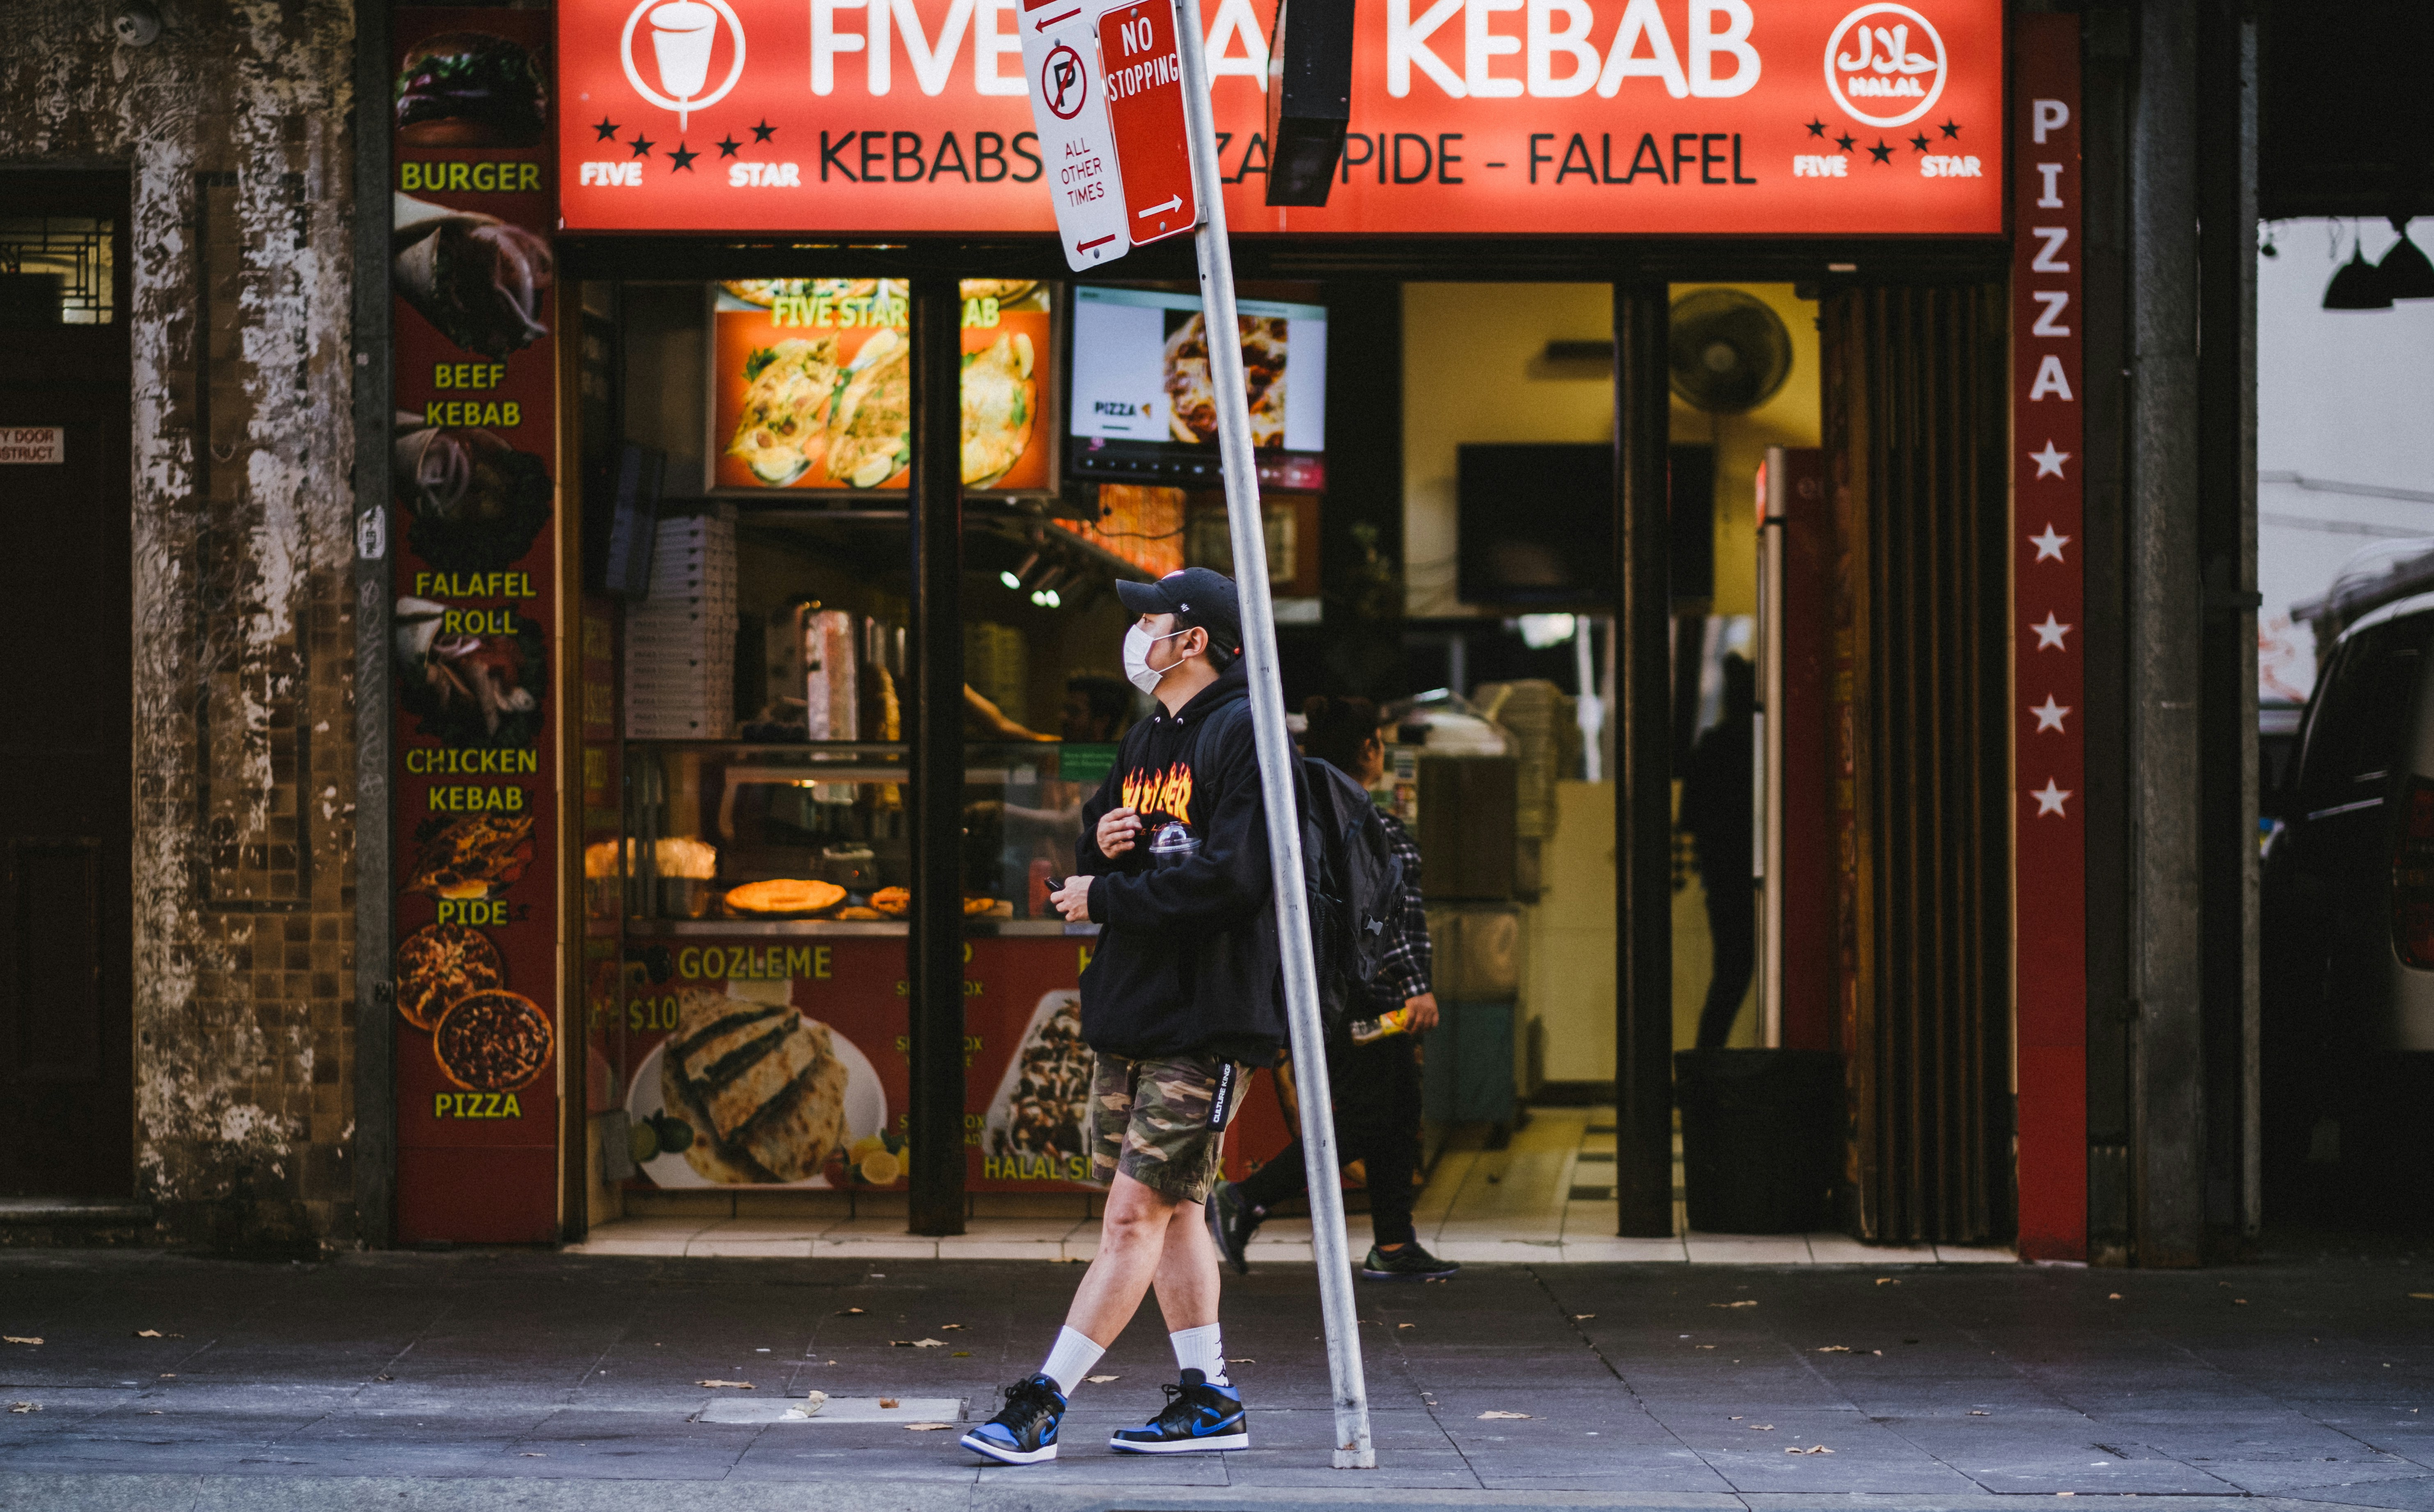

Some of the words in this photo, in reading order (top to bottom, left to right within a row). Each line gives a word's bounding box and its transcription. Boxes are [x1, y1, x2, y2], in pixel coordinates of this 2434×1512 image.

[811, 0, 1029, 96] FIVE
[1121, 17, 1153, 56] NO
[1387, 0, 1761, 98] KEBAB
[1108, 53, 1178, 101] STOPPING
[1848, 77, 1925, 96] HALAL
[821, 131, 1043, 182] KEBABS
[1066, 137, 1090, 159] ALL
[1342, 133, 1463, 184] PIDE
[1530, 133, 1756, 184] FALAFEL
[401, 163, 541, 191] BURGER
[580, 162, 642, 186] FIVE
[729, 162, 800, 187] STAR
[1061, 157, 1102, 185] OTHER
[1793, 155, 1847, 177] FIVE
[1921, 155, 1982, 177] STAR
[1067, 181, 1105, 207] TIMES
[2029, 99, 2074, 401] PIZZA
[772, 296, 833, 327] FIVE
[838, 296, 909, 327] STAR
[435, 364, 505, 389] BEEF
[426, 402, 521, 426] KEBAB
[1095, 401, 1136, 416] PIZZA
[416, 573, 536, 596] FALAFEL
[445, 610, 518, 634] ROLL
[407, 749, 537, 772] CHICKEN
[429, 787, 523, 810] KEBAB
[438, 901, 507, 924] PIDE
[678, 946, 832, 978] GOZLEME
[630, 995, 677, 1034] $10
[435, 1093, 521, 1117] PIZZA
[1213, 1088, 1226, 1123] CULTURE
[1222, 1063, 1231, 1086] KINGS
[985, 1156, 1061, 1180] HALAL
